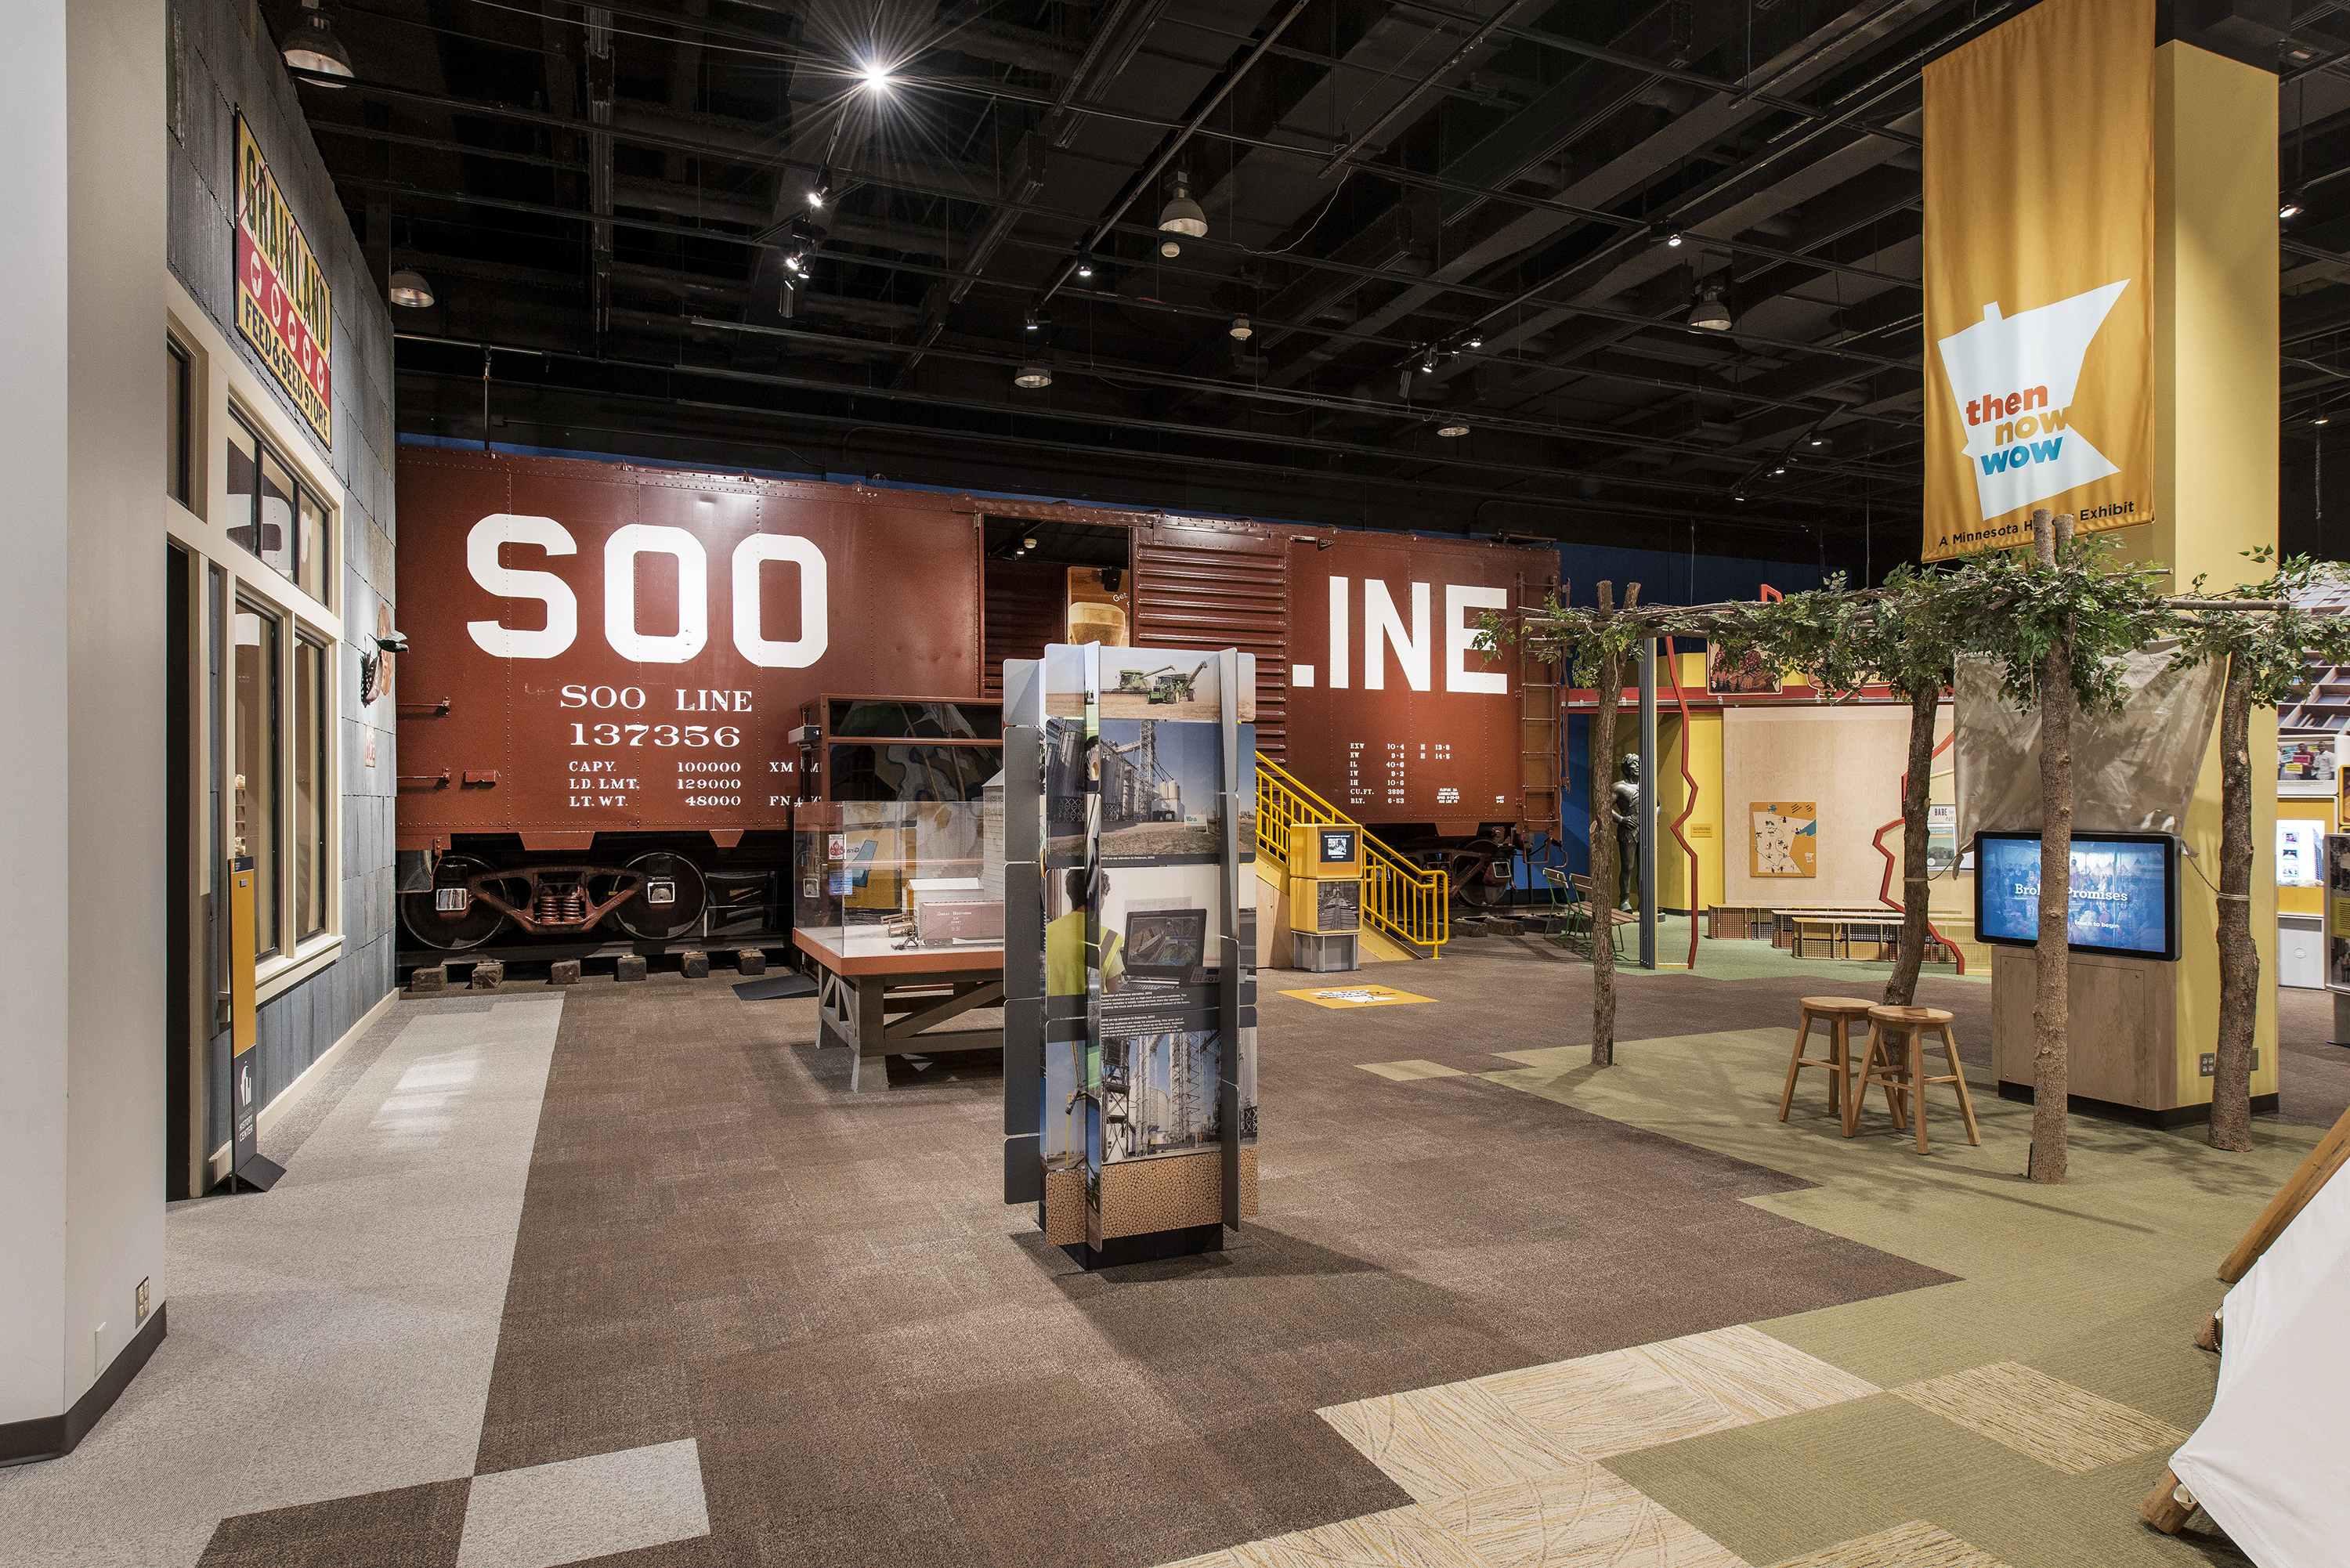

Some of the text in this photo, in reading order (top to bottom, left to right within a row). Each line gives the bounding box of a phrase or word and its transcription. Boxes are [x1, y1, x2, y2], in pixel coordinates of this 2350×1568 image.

[246, 145, 326, 351] GRAINLAND
[246, 294, 327, 437] FEED & SEED STORE
[1966, 385, 2048, 426] then
[1995, 406, 2070, 446] now
[1981, 436, 2063, 475] wow
[1939, 501, 2135, 547] A Minnesota Exhibit
[467, 513, 828, 668] SOO
[1112, 592, 1128, 602] Get
[1292, 576, 1507, 694] INE
[560, 685, 752, 712] SOO LINE
[570, 724, 740, 747] 137356
[569, 761, 794, 772] CAPY. 100000 XM
[569, 779, 741, 789] LD. LMT. 129000
[569, 796, 790, 807] LT. WT. 48000 FN
[2015, 883, 2040, 895] Bro
[239, 1124, 253, 1142] CENTER
